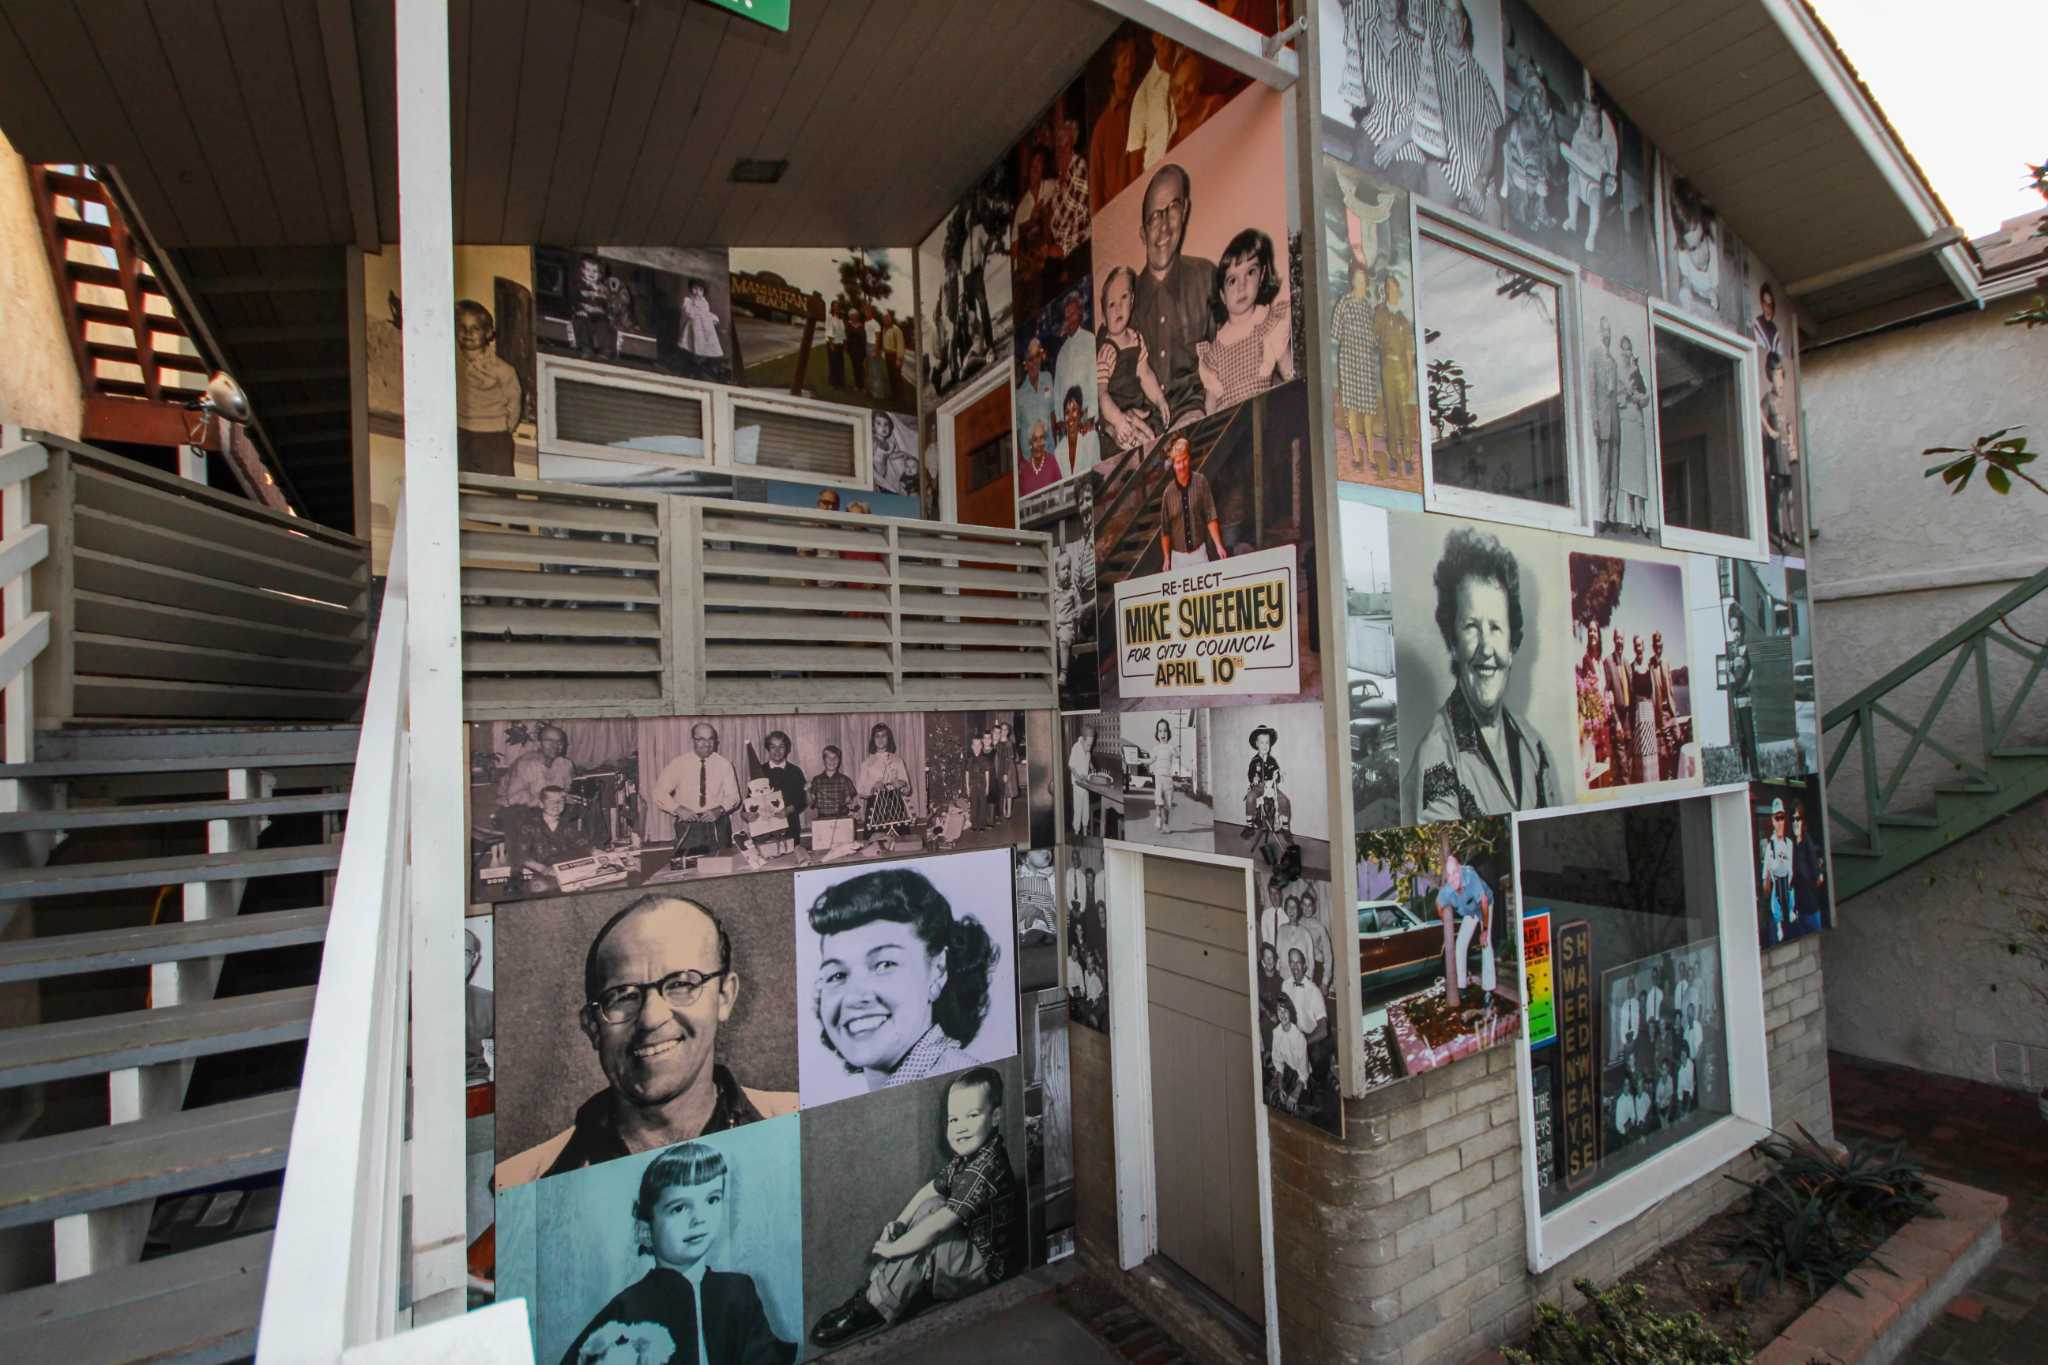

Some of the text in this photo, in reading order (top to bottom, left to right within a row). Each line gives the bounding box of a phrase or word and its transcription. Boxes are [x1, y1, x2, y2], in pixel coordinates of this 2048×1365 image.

[1161, 572, 1222, 597] RE-ELECT
[1125, 582, 1284, 644] MIKE SWEENEY
[1127, 634, 1276, 663] FOR CITY COUNCIL
[1155, 661, 1205, 687] APRIL
